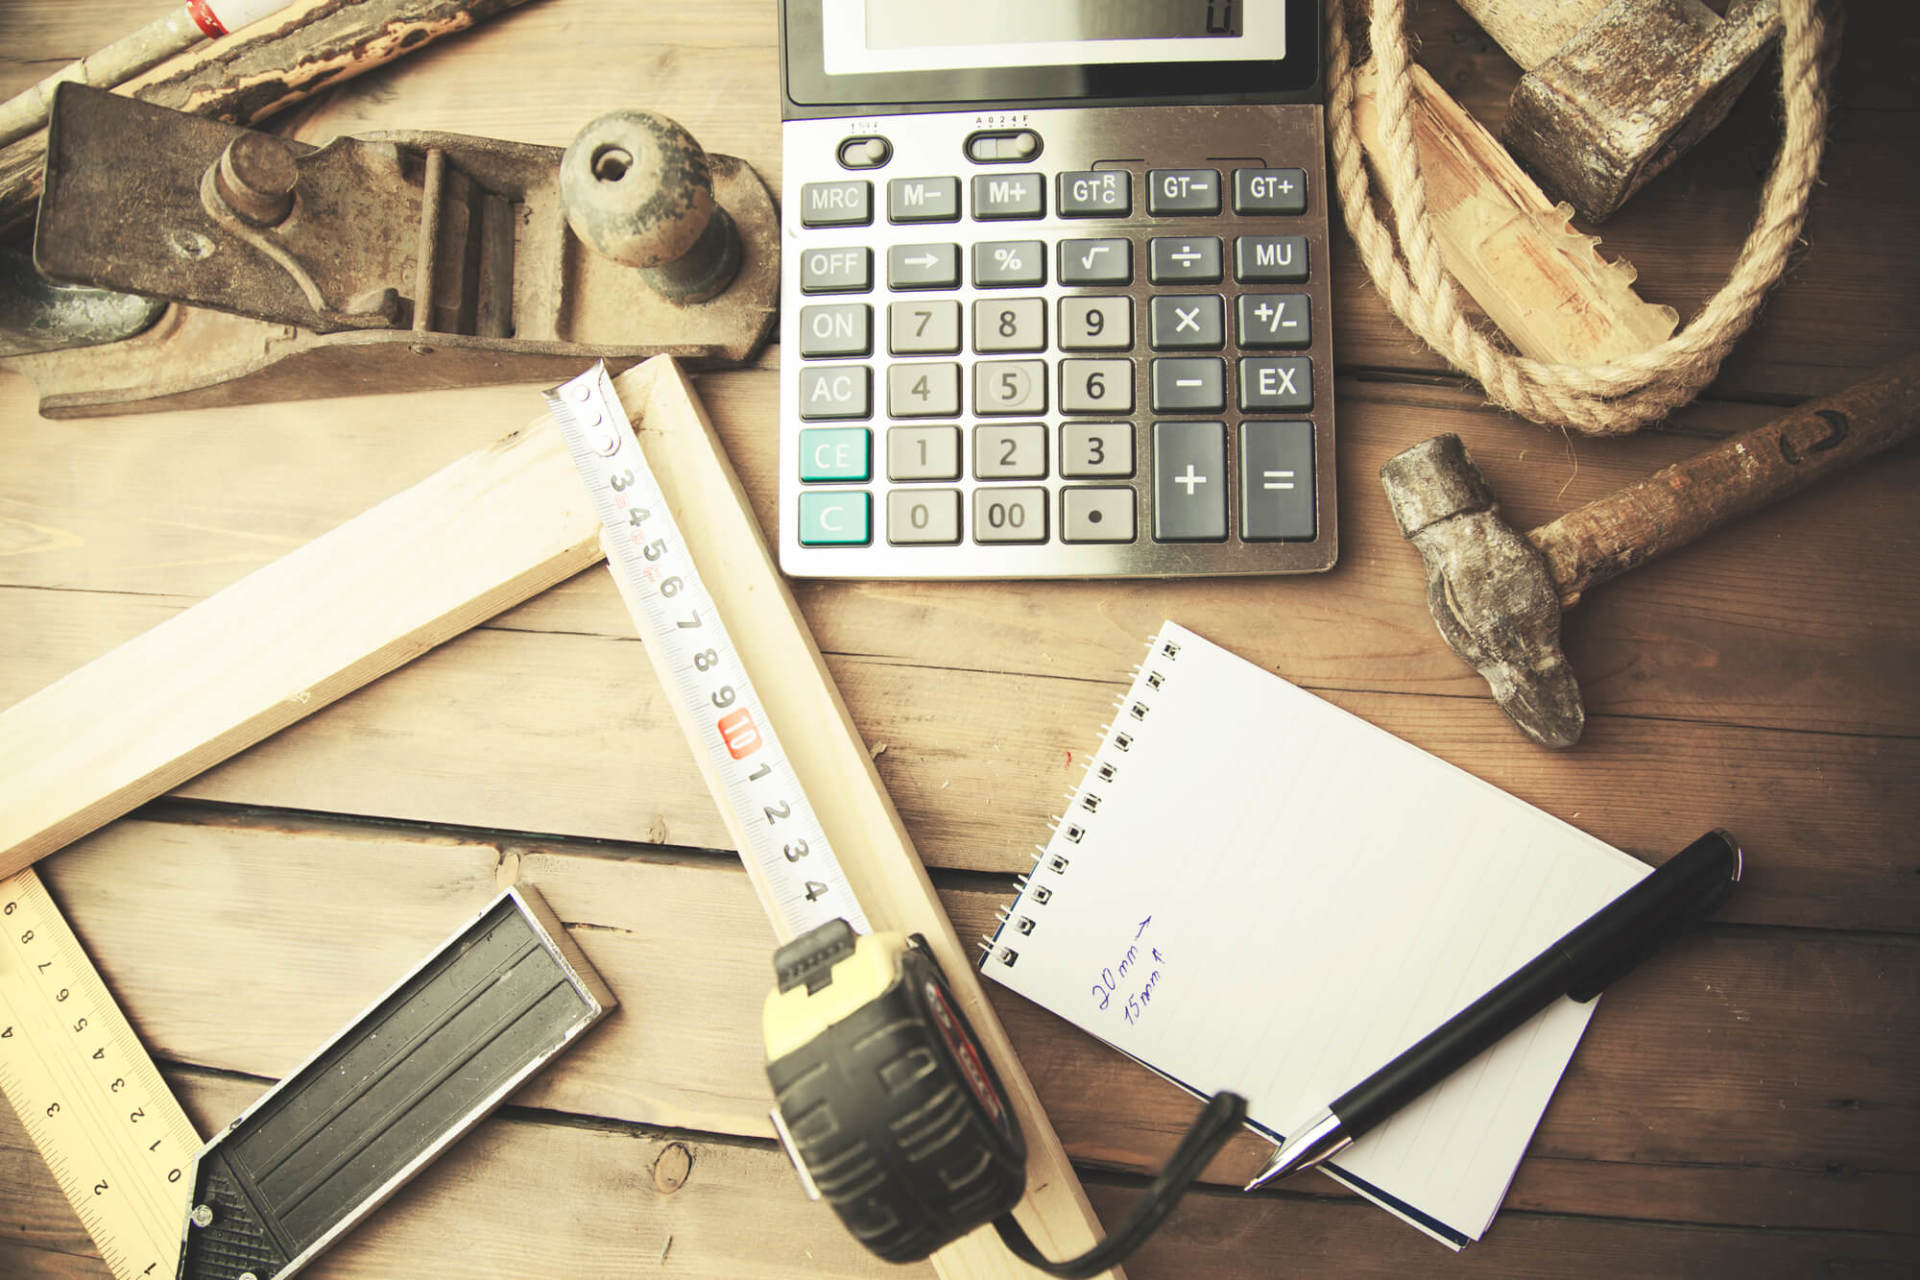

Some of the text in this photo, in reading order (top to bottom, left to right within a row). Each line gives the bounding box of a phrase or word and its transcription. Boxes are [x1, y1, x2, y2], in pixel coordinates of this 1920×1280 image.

[812, 186, 859, 209] MRC
[989, 181, 1027, 203] M+
[1250, 176, 1294, 198] GT+
[811, 252, 859, 275] OFF
[1256, 243, 1292, 266] MU
[812, 312, 853, 338] ON
[914, 311, 932, 338] 7
[998, 310, 1017, 338] 8
[1085, 308, 1105, 337] 9
[811, 375, 853, 402] AC
[911, 375, 931, 402] 4
[1001, 372, 1018, 401] 5
[1086, 372, 1106, 400] 6
[1259, 367, 1297, 395] EX
[815, 443, 851, 469] CE
[916, 439, 927, 466] 1
[999, 438, 1017, 466] 2
[1087, 436, 1105, 465] 3
[611, 469, 635, 492] 3
[630, 507, 650, 527] 4
[819, 506, 844, 531] C
[910, 503, 929, 530] 0
[988, 503, 1025, 529] 00
[643, 538, 668, 562] 5
[659, 576, 684, 599] 6
[676, 610, 702, 630] 7
[694, 648, 719, 672] 8
[711, 685, 736, 709] 9
[723, 715, 757, 750] 10
[748, 762, 772, 782] 1
[763, 800, 791, 825] 2
[783, 838, 809, 863] 3
[804, 879, 829, 902] 4
[1091, 967, 1116, 1010] 20
[4, 901, 182, 1183] 0 1 2 3 4 5 6 7 8 9
[0, 1026, 157, 1276] 1 2 3 4
